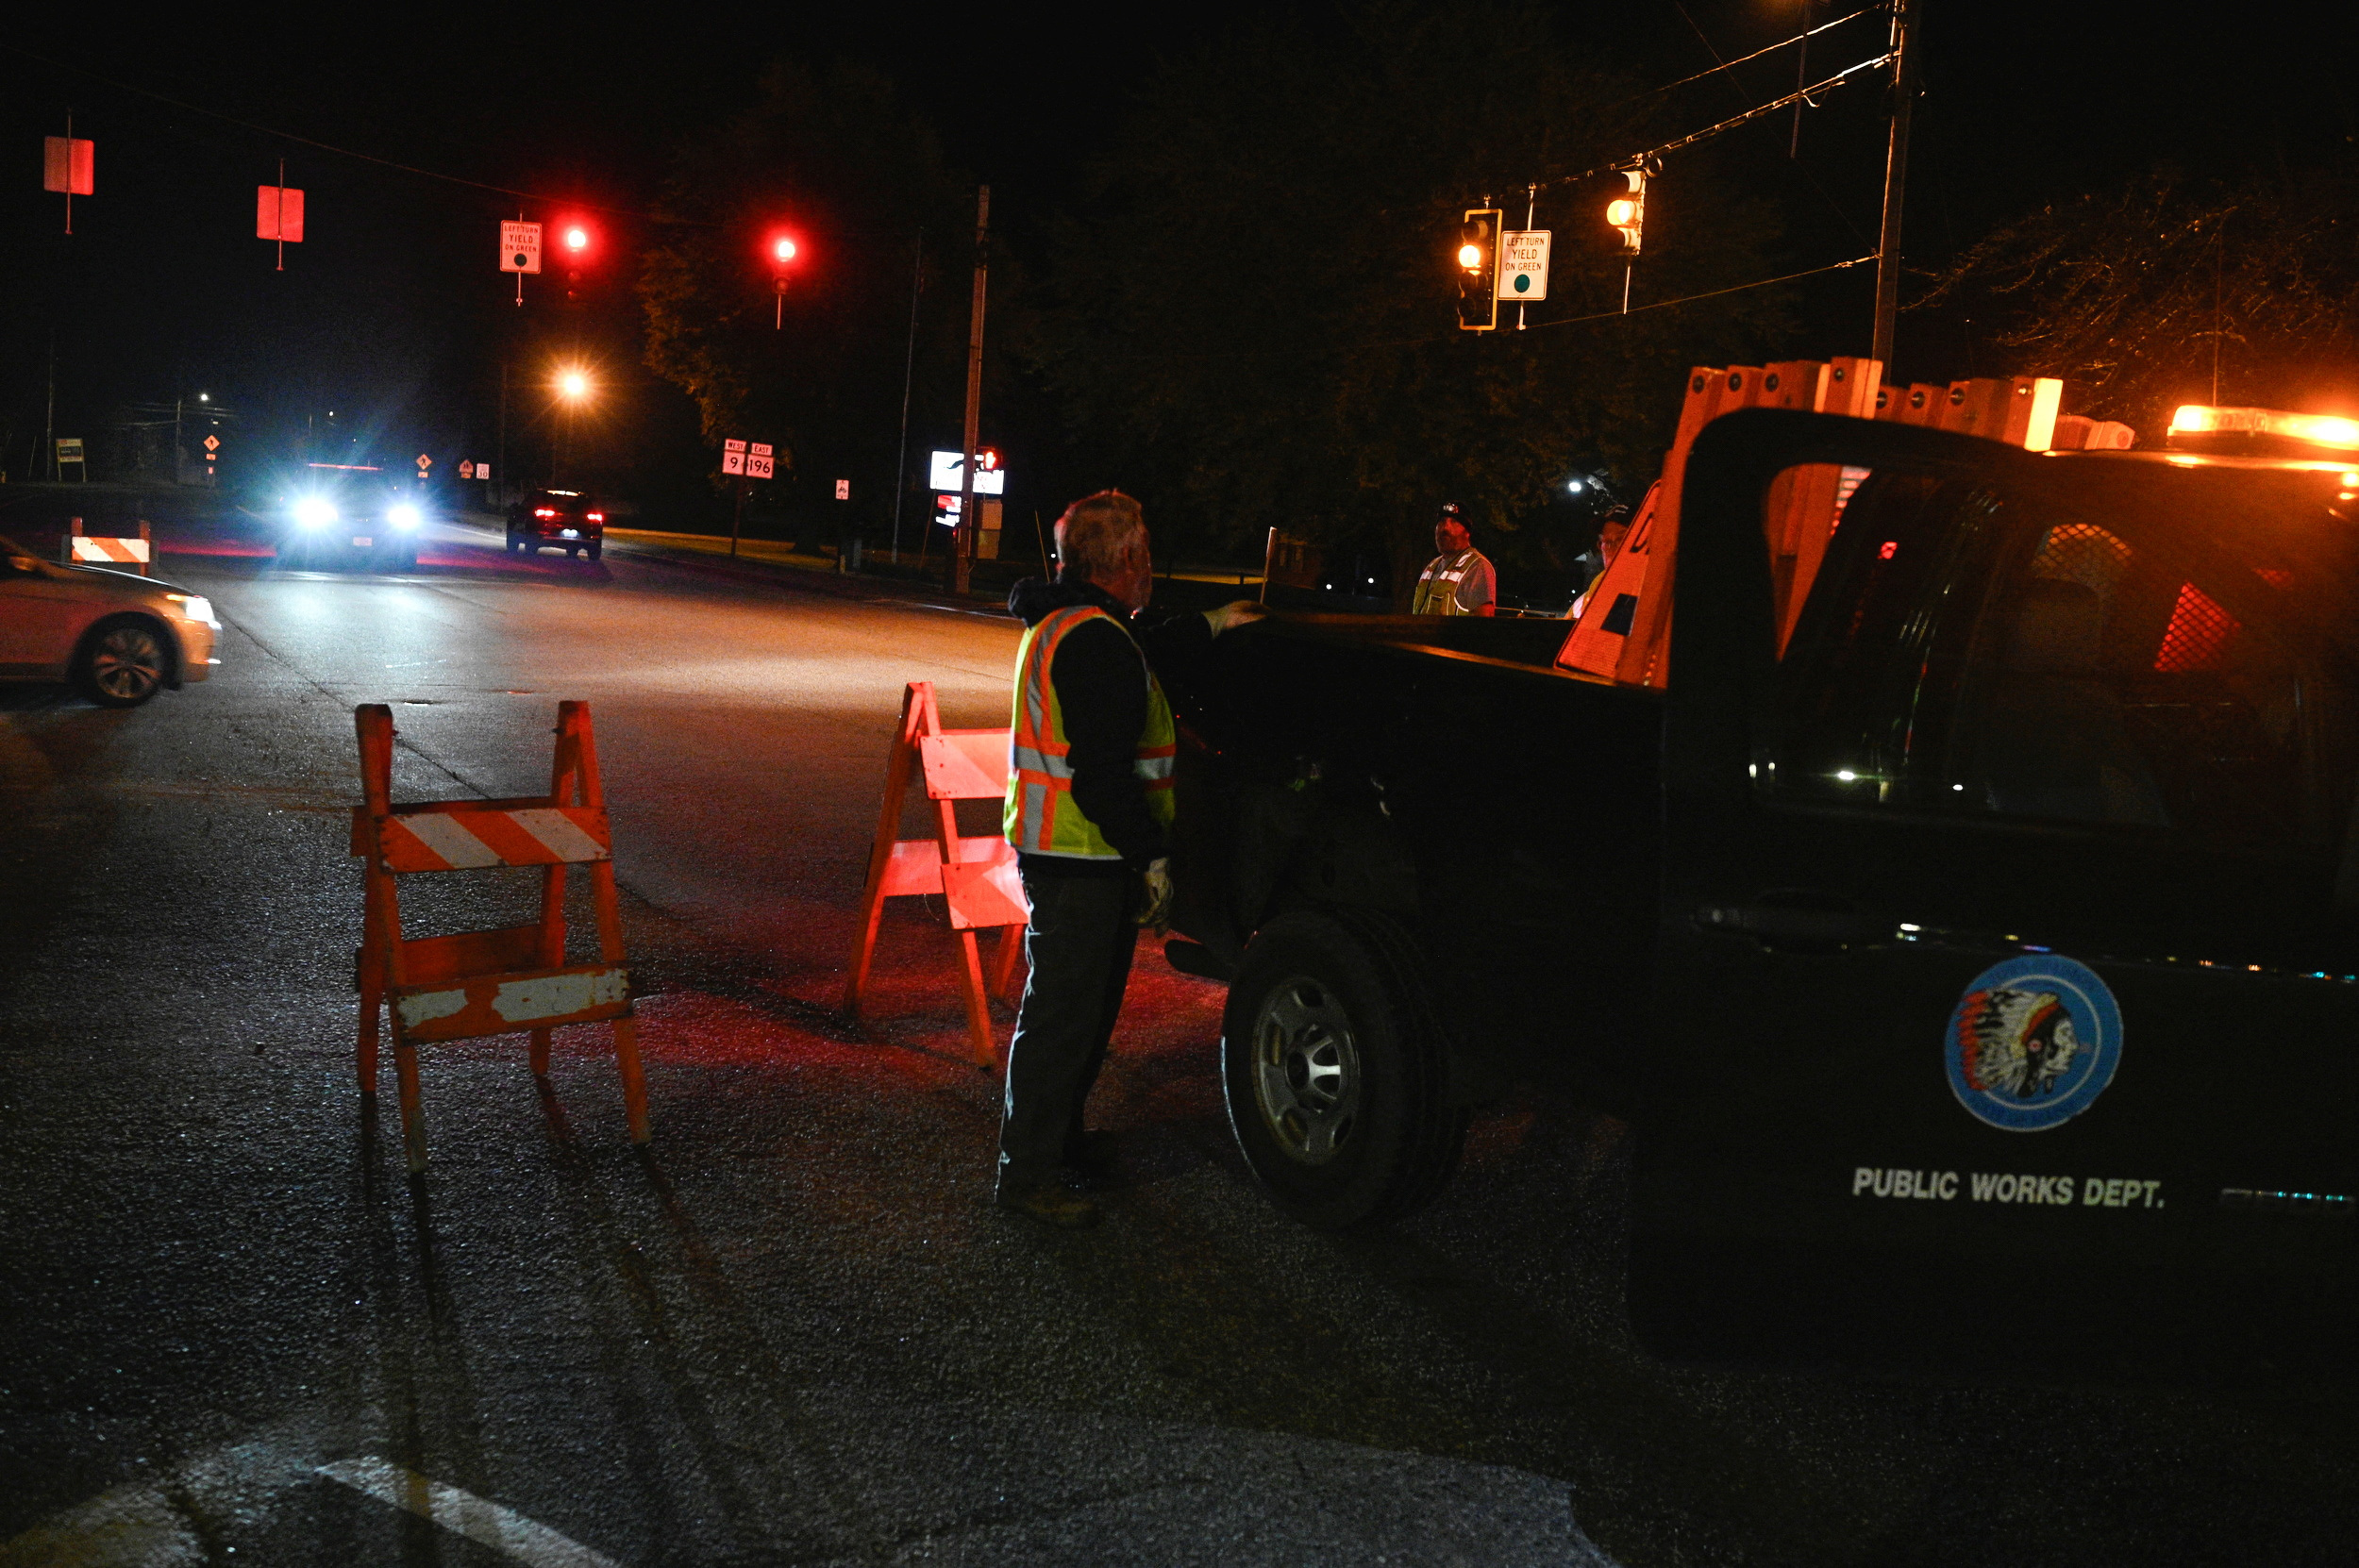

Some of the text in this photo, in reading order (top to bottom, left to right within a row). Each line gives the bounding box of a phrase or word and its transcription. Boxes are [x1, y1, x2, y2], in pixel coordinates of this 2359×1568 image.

[510, 235, 533, 243] YIELD
[1507, 237, 1545, 246] LEFT TURN
[1512, 249, 1538, 259] YIELD
[1505, 262, 1542, 271] ON GREEN
[728, 442, 744, 450] WEST
[754, 444, 769, 453] EAST
[730, 457, 738, 469] 9
[749, 459, 770, 474] 196
[1852, 1167, 2165, 1209] PUBLIC WORKS DEPT.
